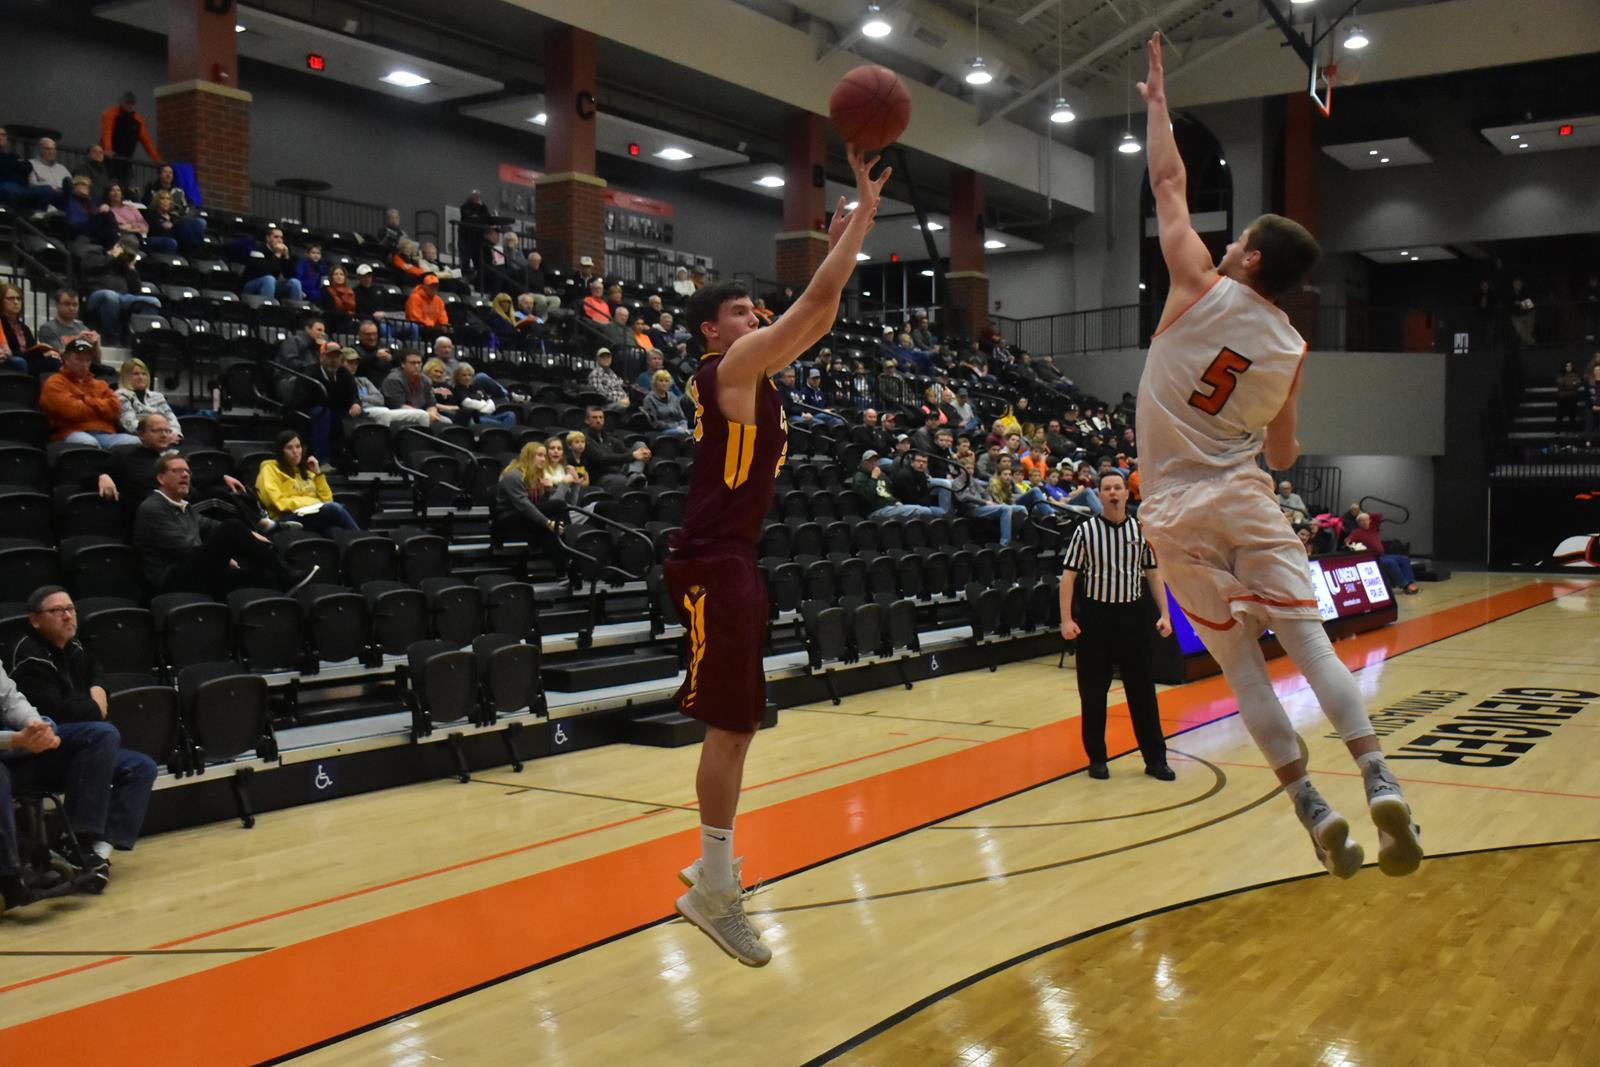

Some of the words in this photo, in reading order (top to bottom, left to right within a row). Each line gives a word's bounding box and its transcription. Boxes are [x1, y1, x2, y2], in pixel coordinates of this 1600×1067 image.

[575, 90, 593, 119] C
[1188, 346, 1253, 416] 5
[1384, 687, 1600, 768] GIENGER
